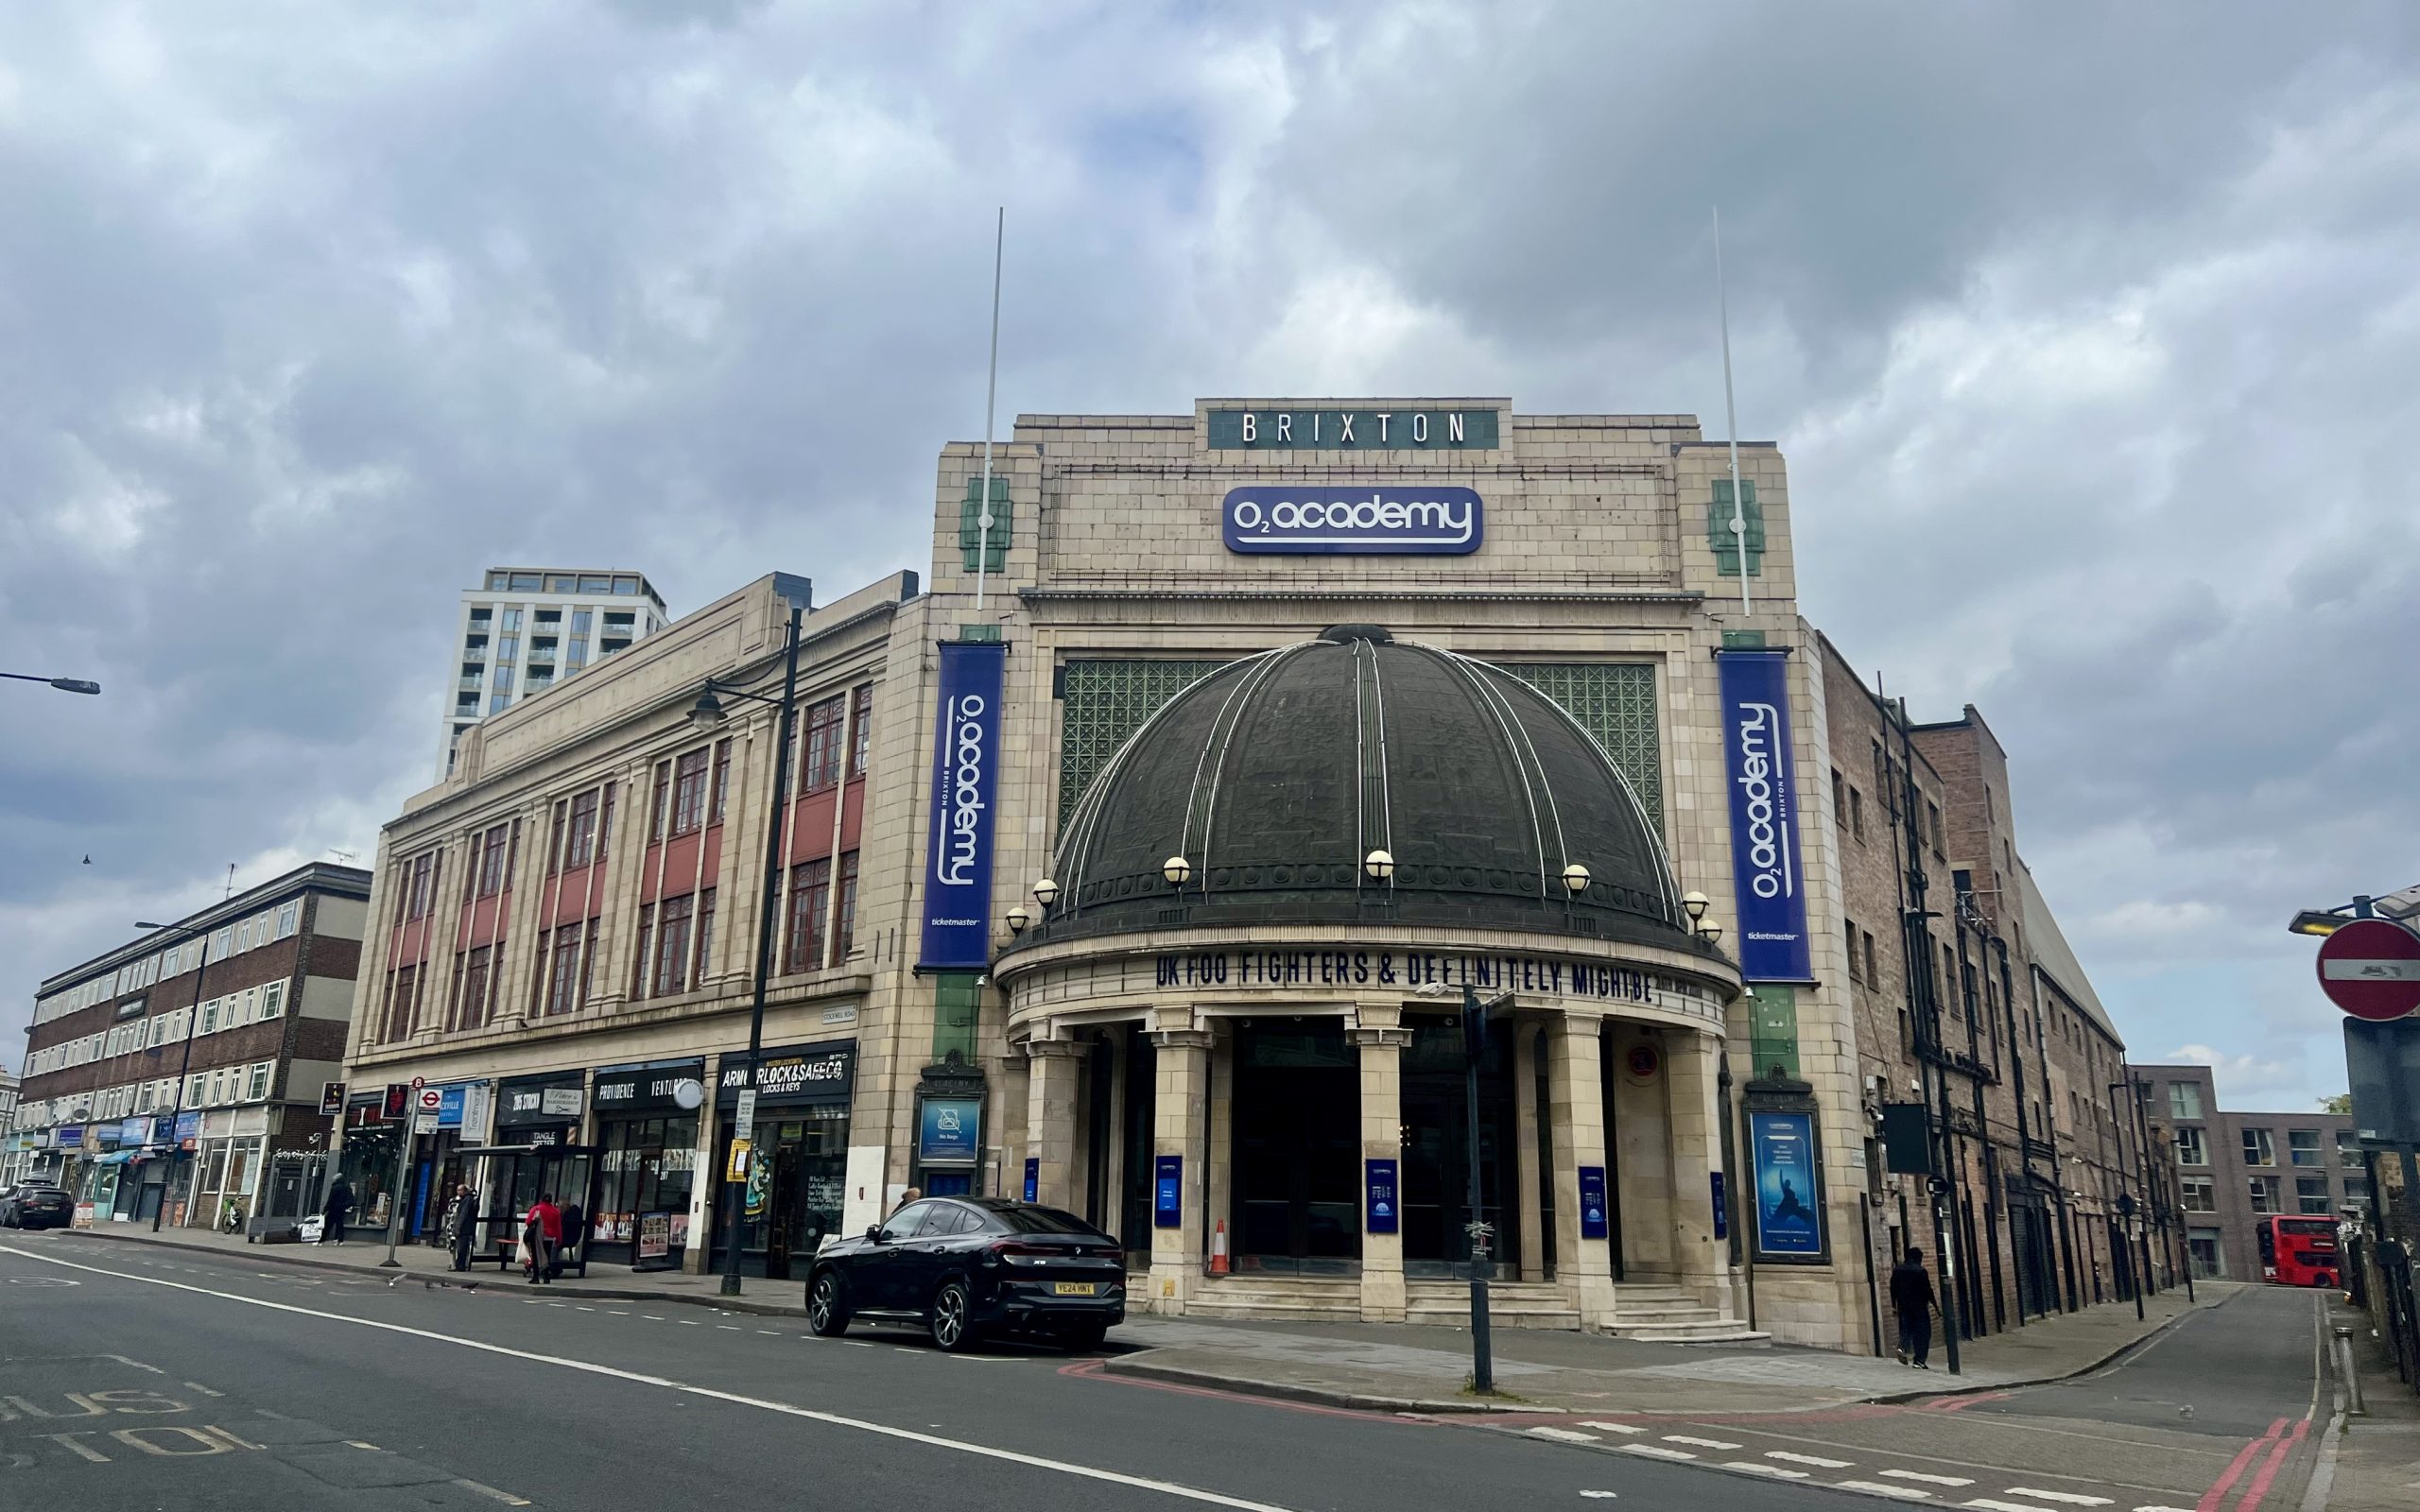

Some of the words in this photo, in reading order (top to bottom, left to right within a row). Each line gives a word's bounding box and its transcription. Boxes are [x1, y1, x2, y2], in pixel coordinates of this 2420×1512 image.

[1242, 413, 1464, 442] BRIXTON
[942, 766, 950, 806] BRIXTON
[1779, 781, 1788, 818] BRIXTON
[931, 918, 979, 927] ticketmaster
[1747, 931, 1797, 942] ticketmaster
[1156, 954, 1180, 986] UK
[1186, 953, 1227, 984] FOO
[1241, 951, 1369, 984] FIGHTERS
[1379, 953, 1396, 984] &
[1408, 954, 1562, 992] DEFINITELY
[599, 1083, 635, 1101] PROVIDENCE
[762, 1084, 781, 1094] LOCKS
[781, 1083, 786, 1092] &
[786, 1082, 802, 1092] KEYS
[532, 1131, 556, 1140] TANGLE
[1058, 1284, 1077, 1293] YE24
